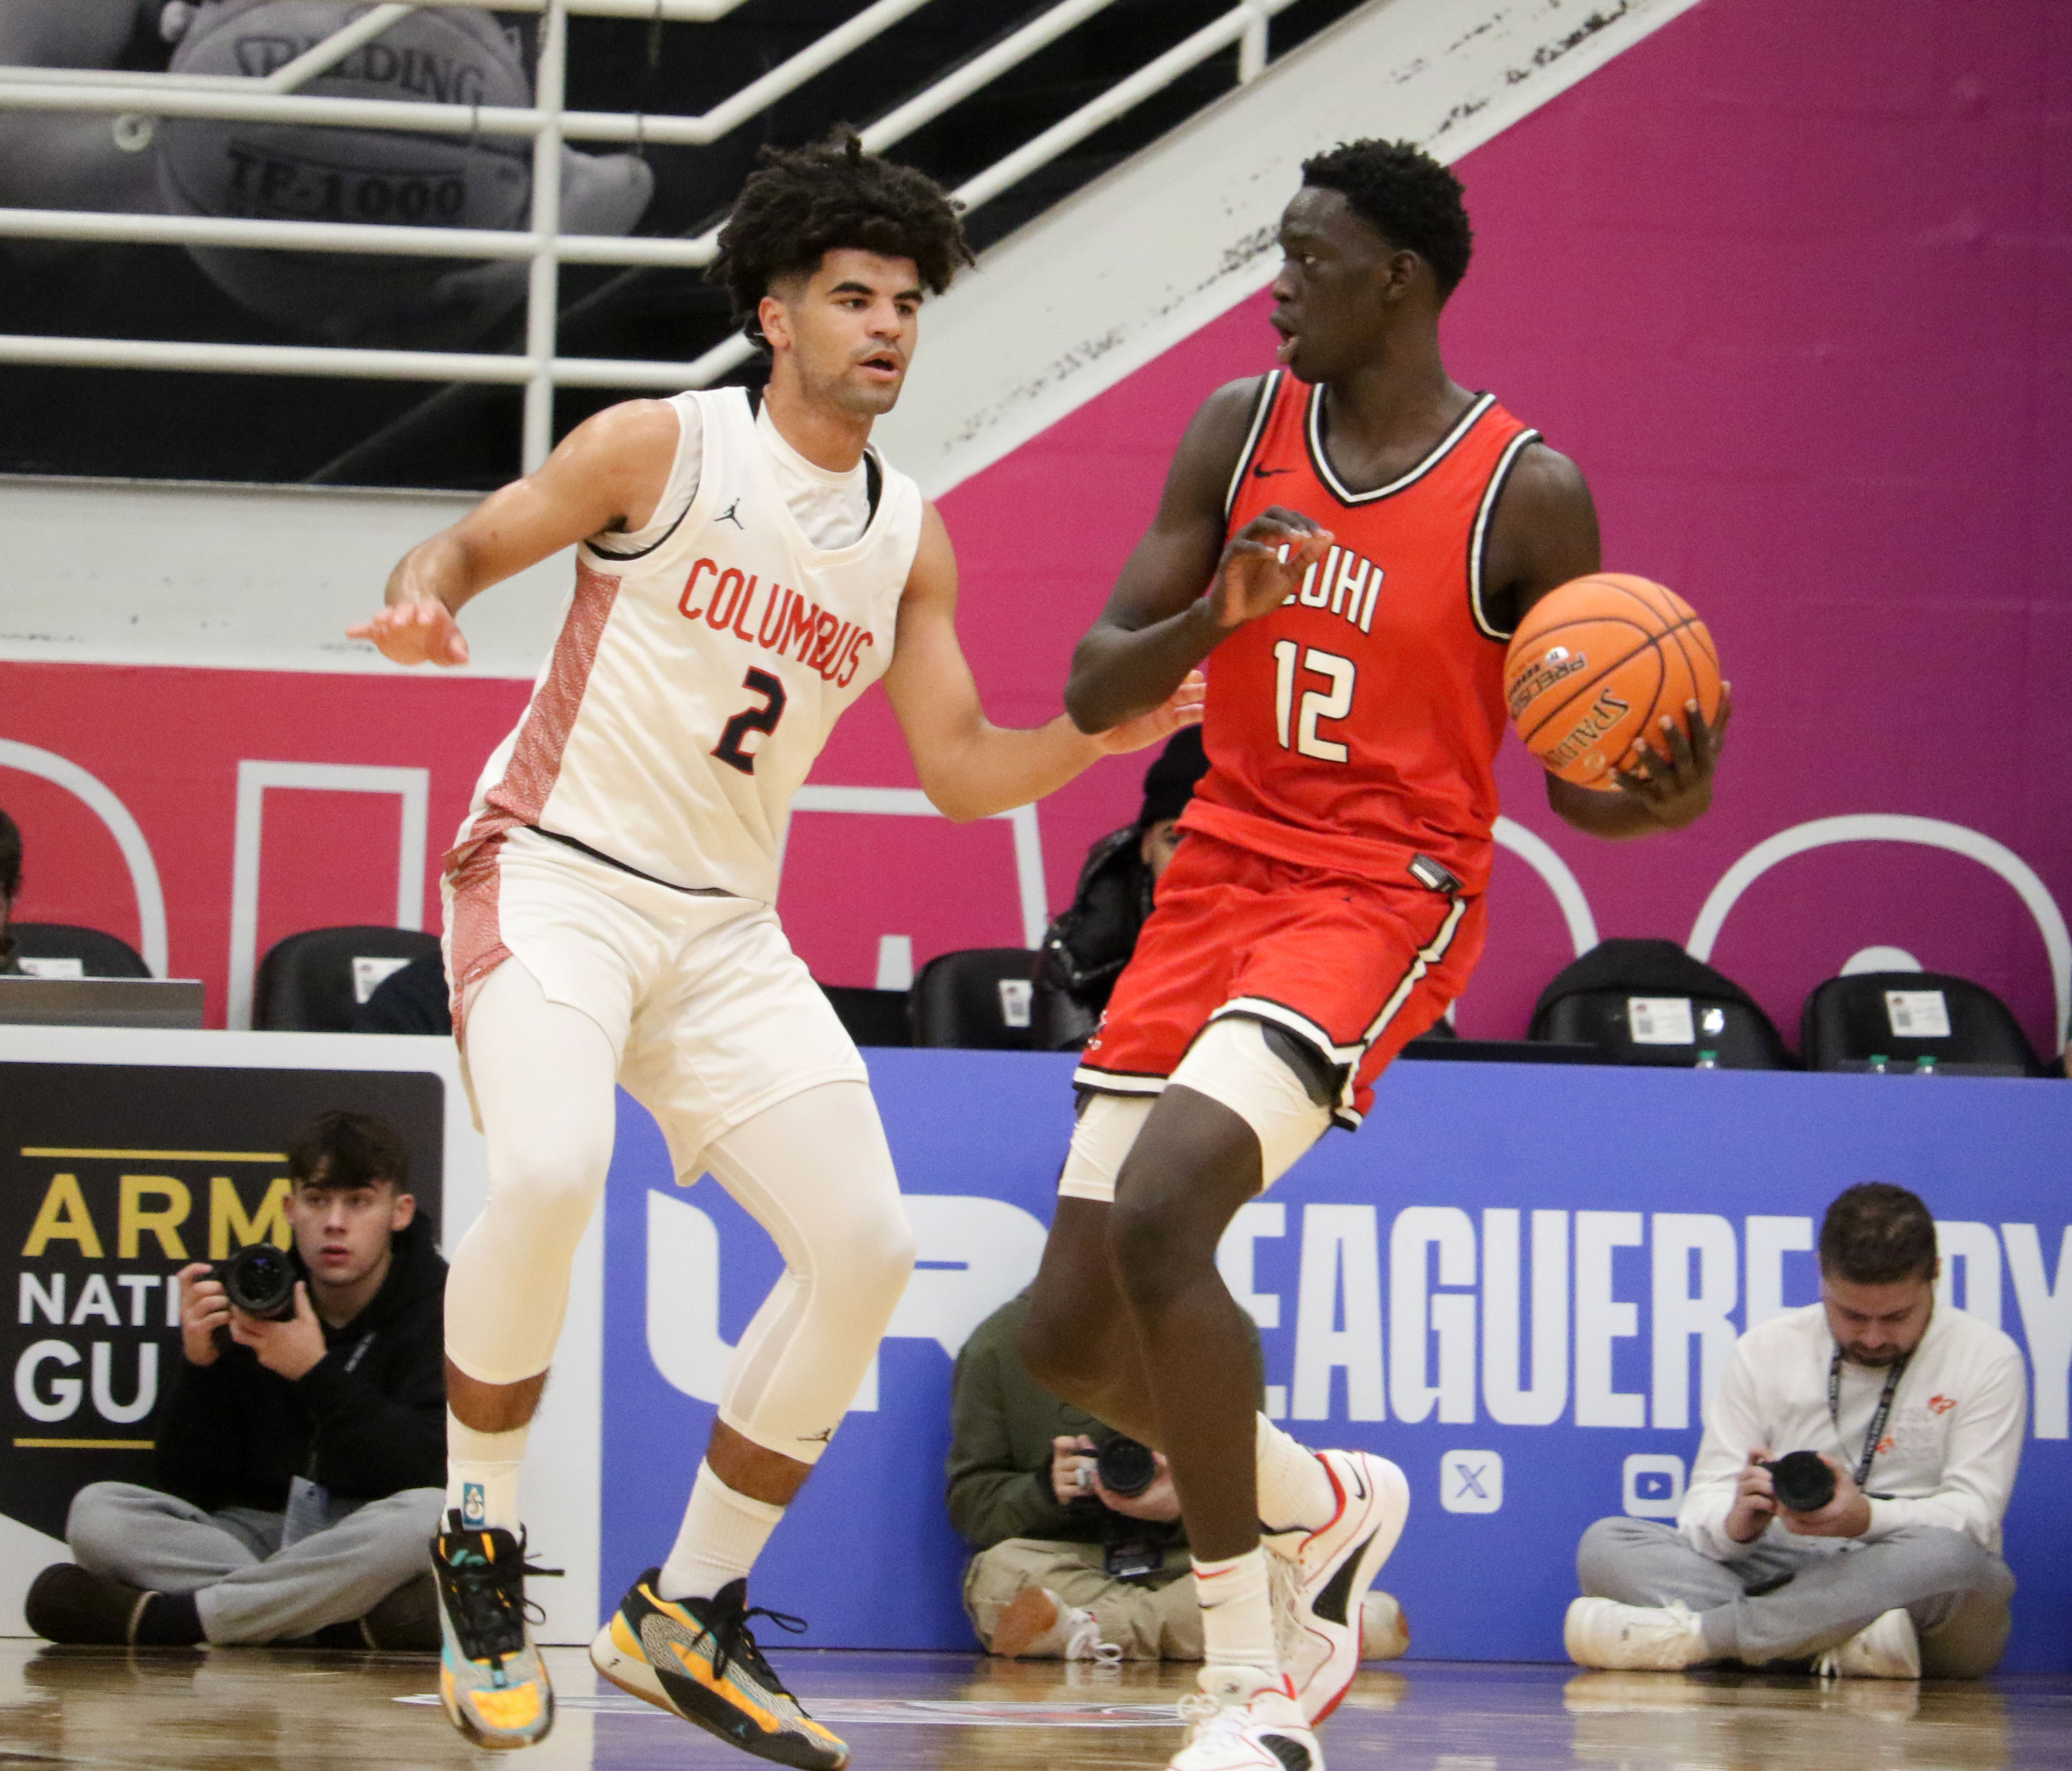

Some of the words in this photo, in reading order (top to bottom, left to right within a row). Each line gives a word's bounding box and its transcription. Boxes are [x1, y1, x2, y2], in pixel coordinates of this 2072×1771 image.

[678, 557, 873, 688] COLUMBUS
[710, 665, 787, 776] 2
[1274, 638, 1356, 763] 12
[22, 1173, 292, 1260] ARM
[18, 1272, 181, 1328] NATI
